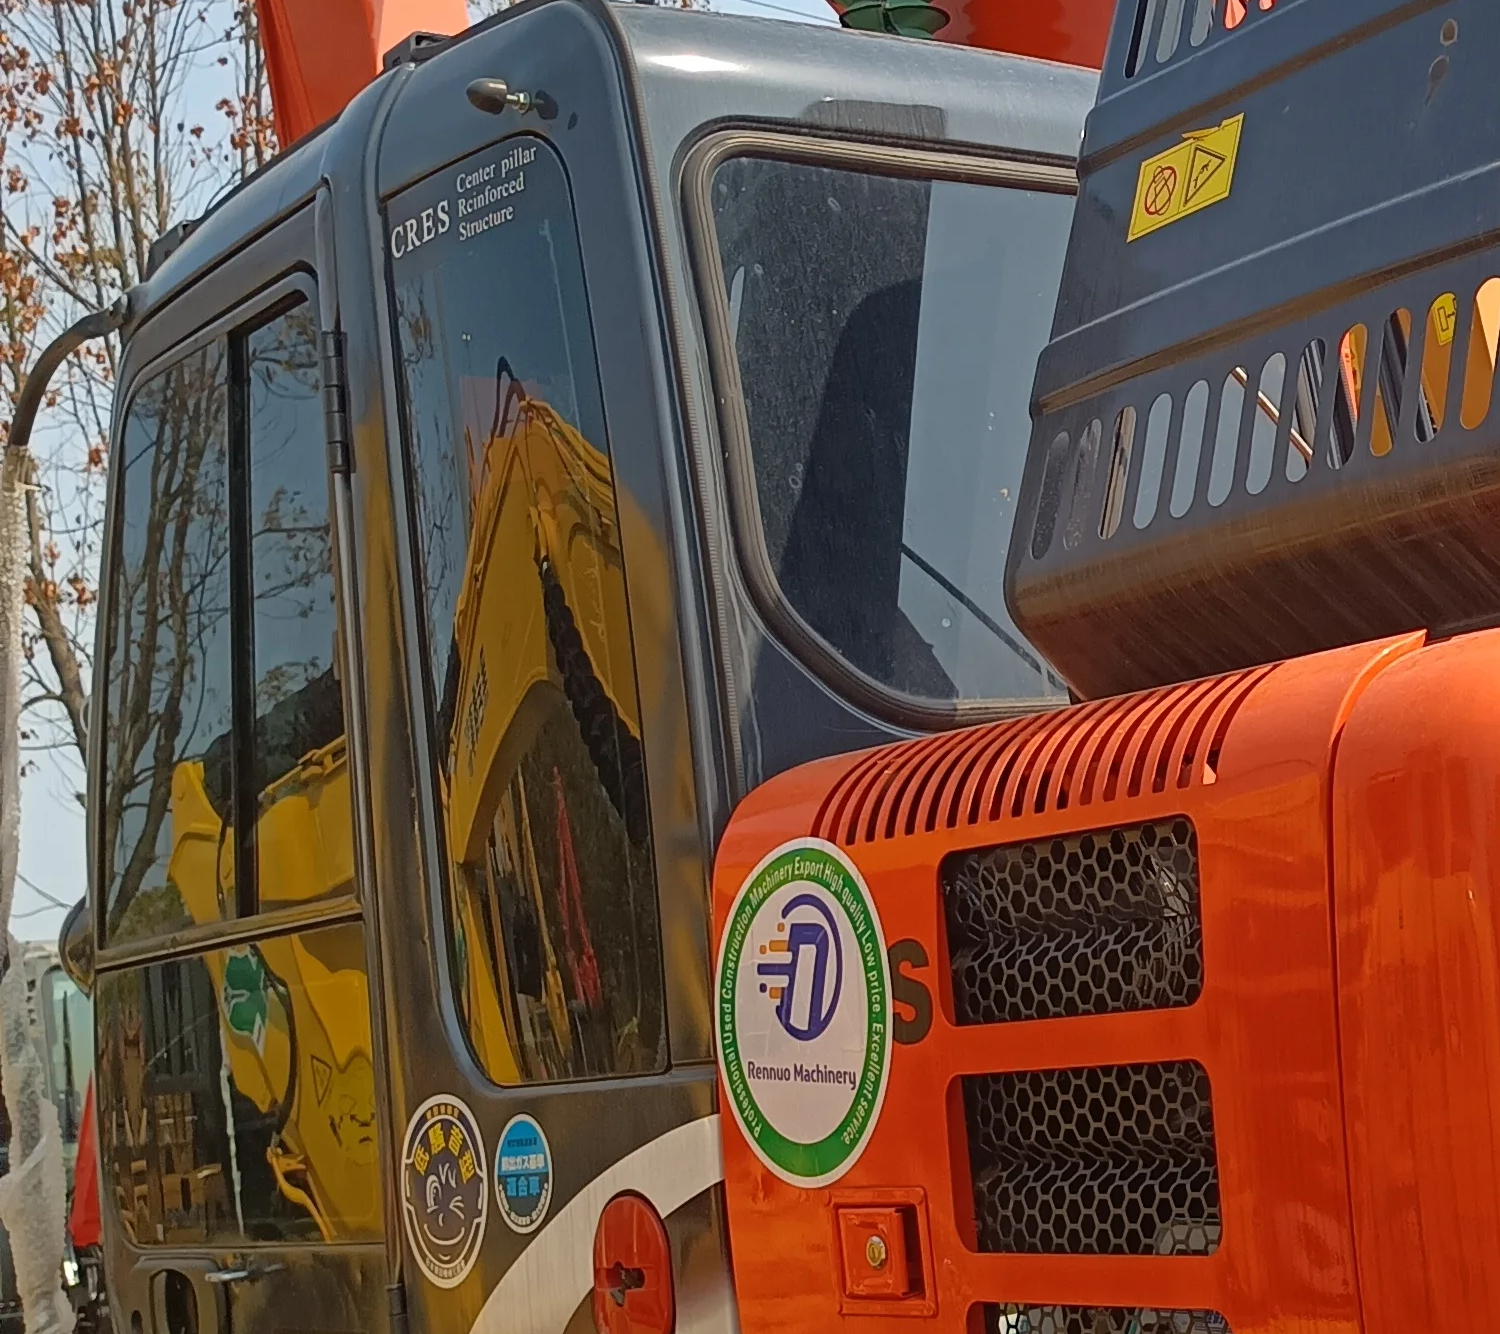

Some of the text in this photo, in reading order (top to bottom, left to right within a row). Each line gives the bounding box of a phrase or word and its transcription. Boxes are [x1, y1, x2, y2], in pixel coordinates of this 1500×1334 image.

[456, 146, 537, 193] Center pillar
[391, 200, 450, 259] CRES
[459, 205, 514, 241] Structure
[749, 863, 794, 906] Machinery
[794, 857, 824, 879] Export
[823, 864, 844, 894] High
[841, 886, 866, 934] quality
[721, 907, 752, 999] Construction
[861, 930, 875, 967] Low
[887, 938, 934, 1045] S
[723, 1003, 733, 1044] Used
[747, 1061, 857, 1091] Rennuo Machinery
[863, 1022, 883, 1100] Excellent
[725, 1048, 762, 1138] Professional
[413, 1121, 476, 1184] 低騒音型
